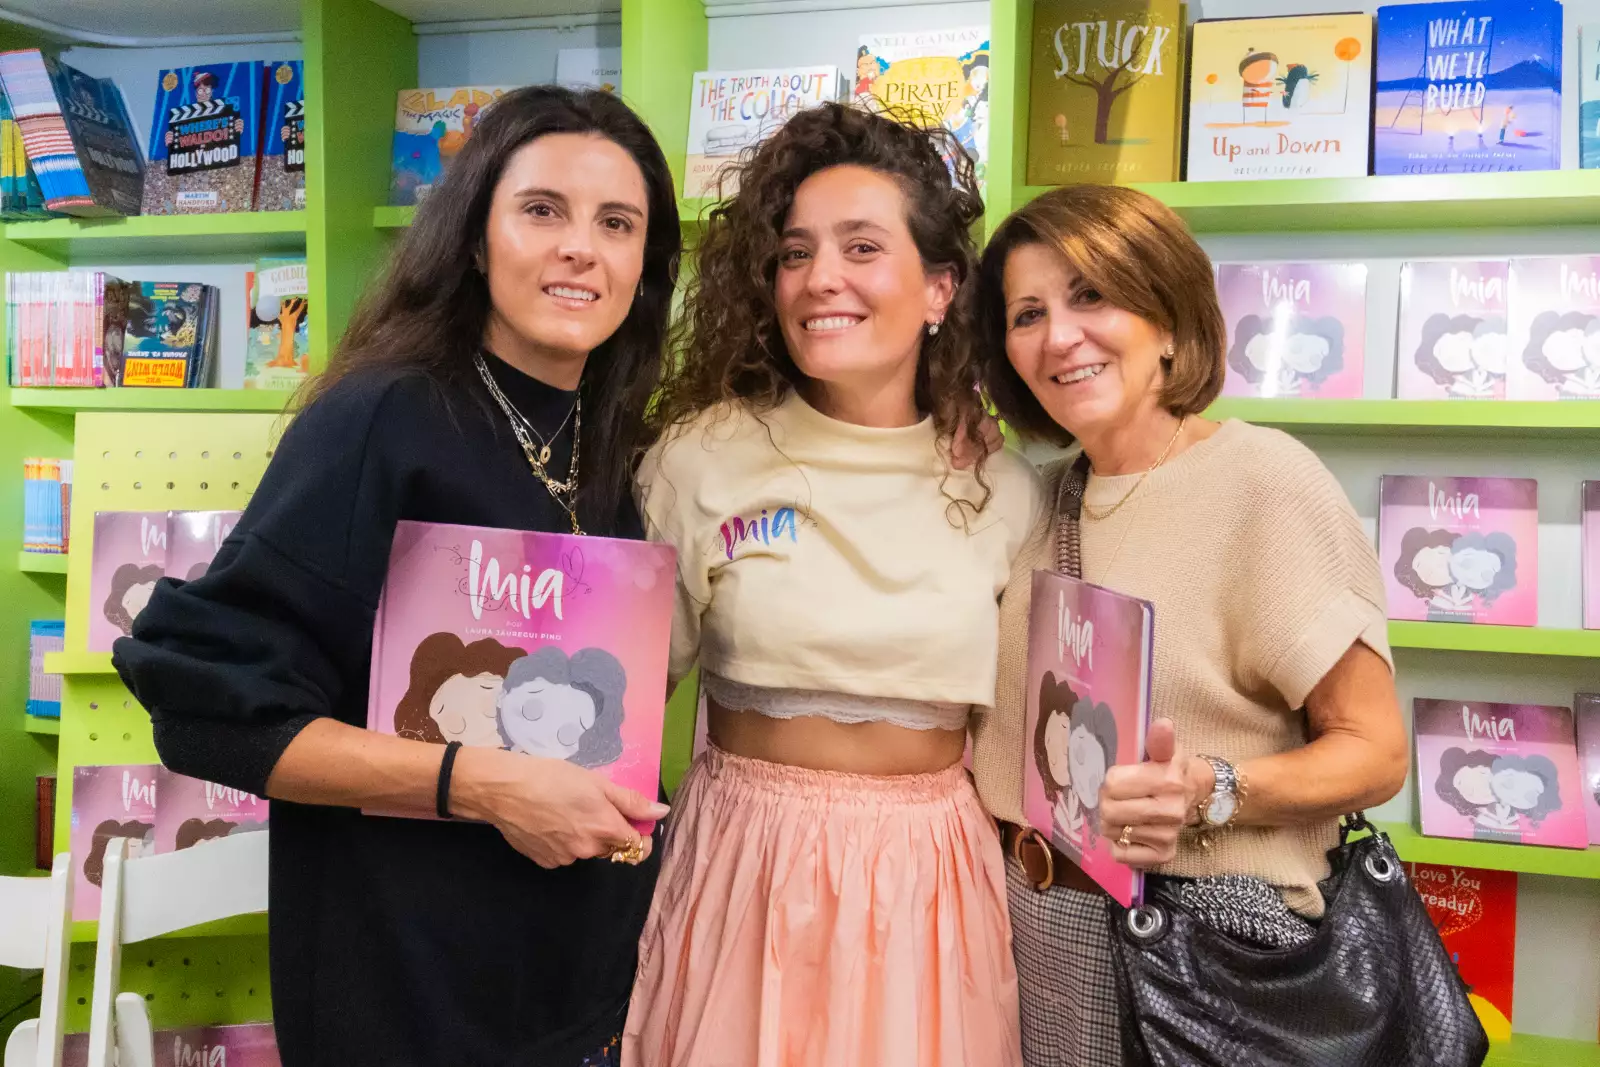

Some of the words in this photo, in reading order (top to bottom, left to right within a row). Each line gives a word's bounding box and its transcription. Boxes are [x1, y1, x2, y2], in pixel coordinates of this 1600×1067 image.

[872, 36, 908, 48] NEIL
[915, 29, 980, 45] GAIMAN
[1428, 16, 1493, 48] WHAT
[1053, 19, 1171, 80] STUCK
[1427, 50, 1486, 82] WE'LL
[401, 87, 504, 114] GLAD
[700, 77, 727, 108] THE
[731, 75, 769, 94] TRUTH
[773, 73, 828, 101] ABOUT
[1426, 81, 1486, 113] BUILD
[417, 108, 460, 123] MAGIC
[711, 96, 737, 122] THE
[179, 129, 229, 148] WALDO?
[180, 117, 229, 135] WHERE'S
[170, 144, 238, 169] HOLLYWOOD
[1213, 136, 1241, 163] Up
[1246, 143, 1270, 156] and
[1276, 132, 1341, 155] Down
[1262, 269, 1311, 308] Mia
[1429, 480, 1480, 520] Mia
[720, 506, 797, 560] Mia
[469, 539, 564, 620] Mia
[465, 627, 493, 635] LAURA
[1058, 589, 1093, 672] Mia
[1462, 705, 1517, 742] Mia
[1411, 862, 1447, 883] Love
[1451, 868, 1480, 890] You
[174, 1035, 226, 1067] Mia
